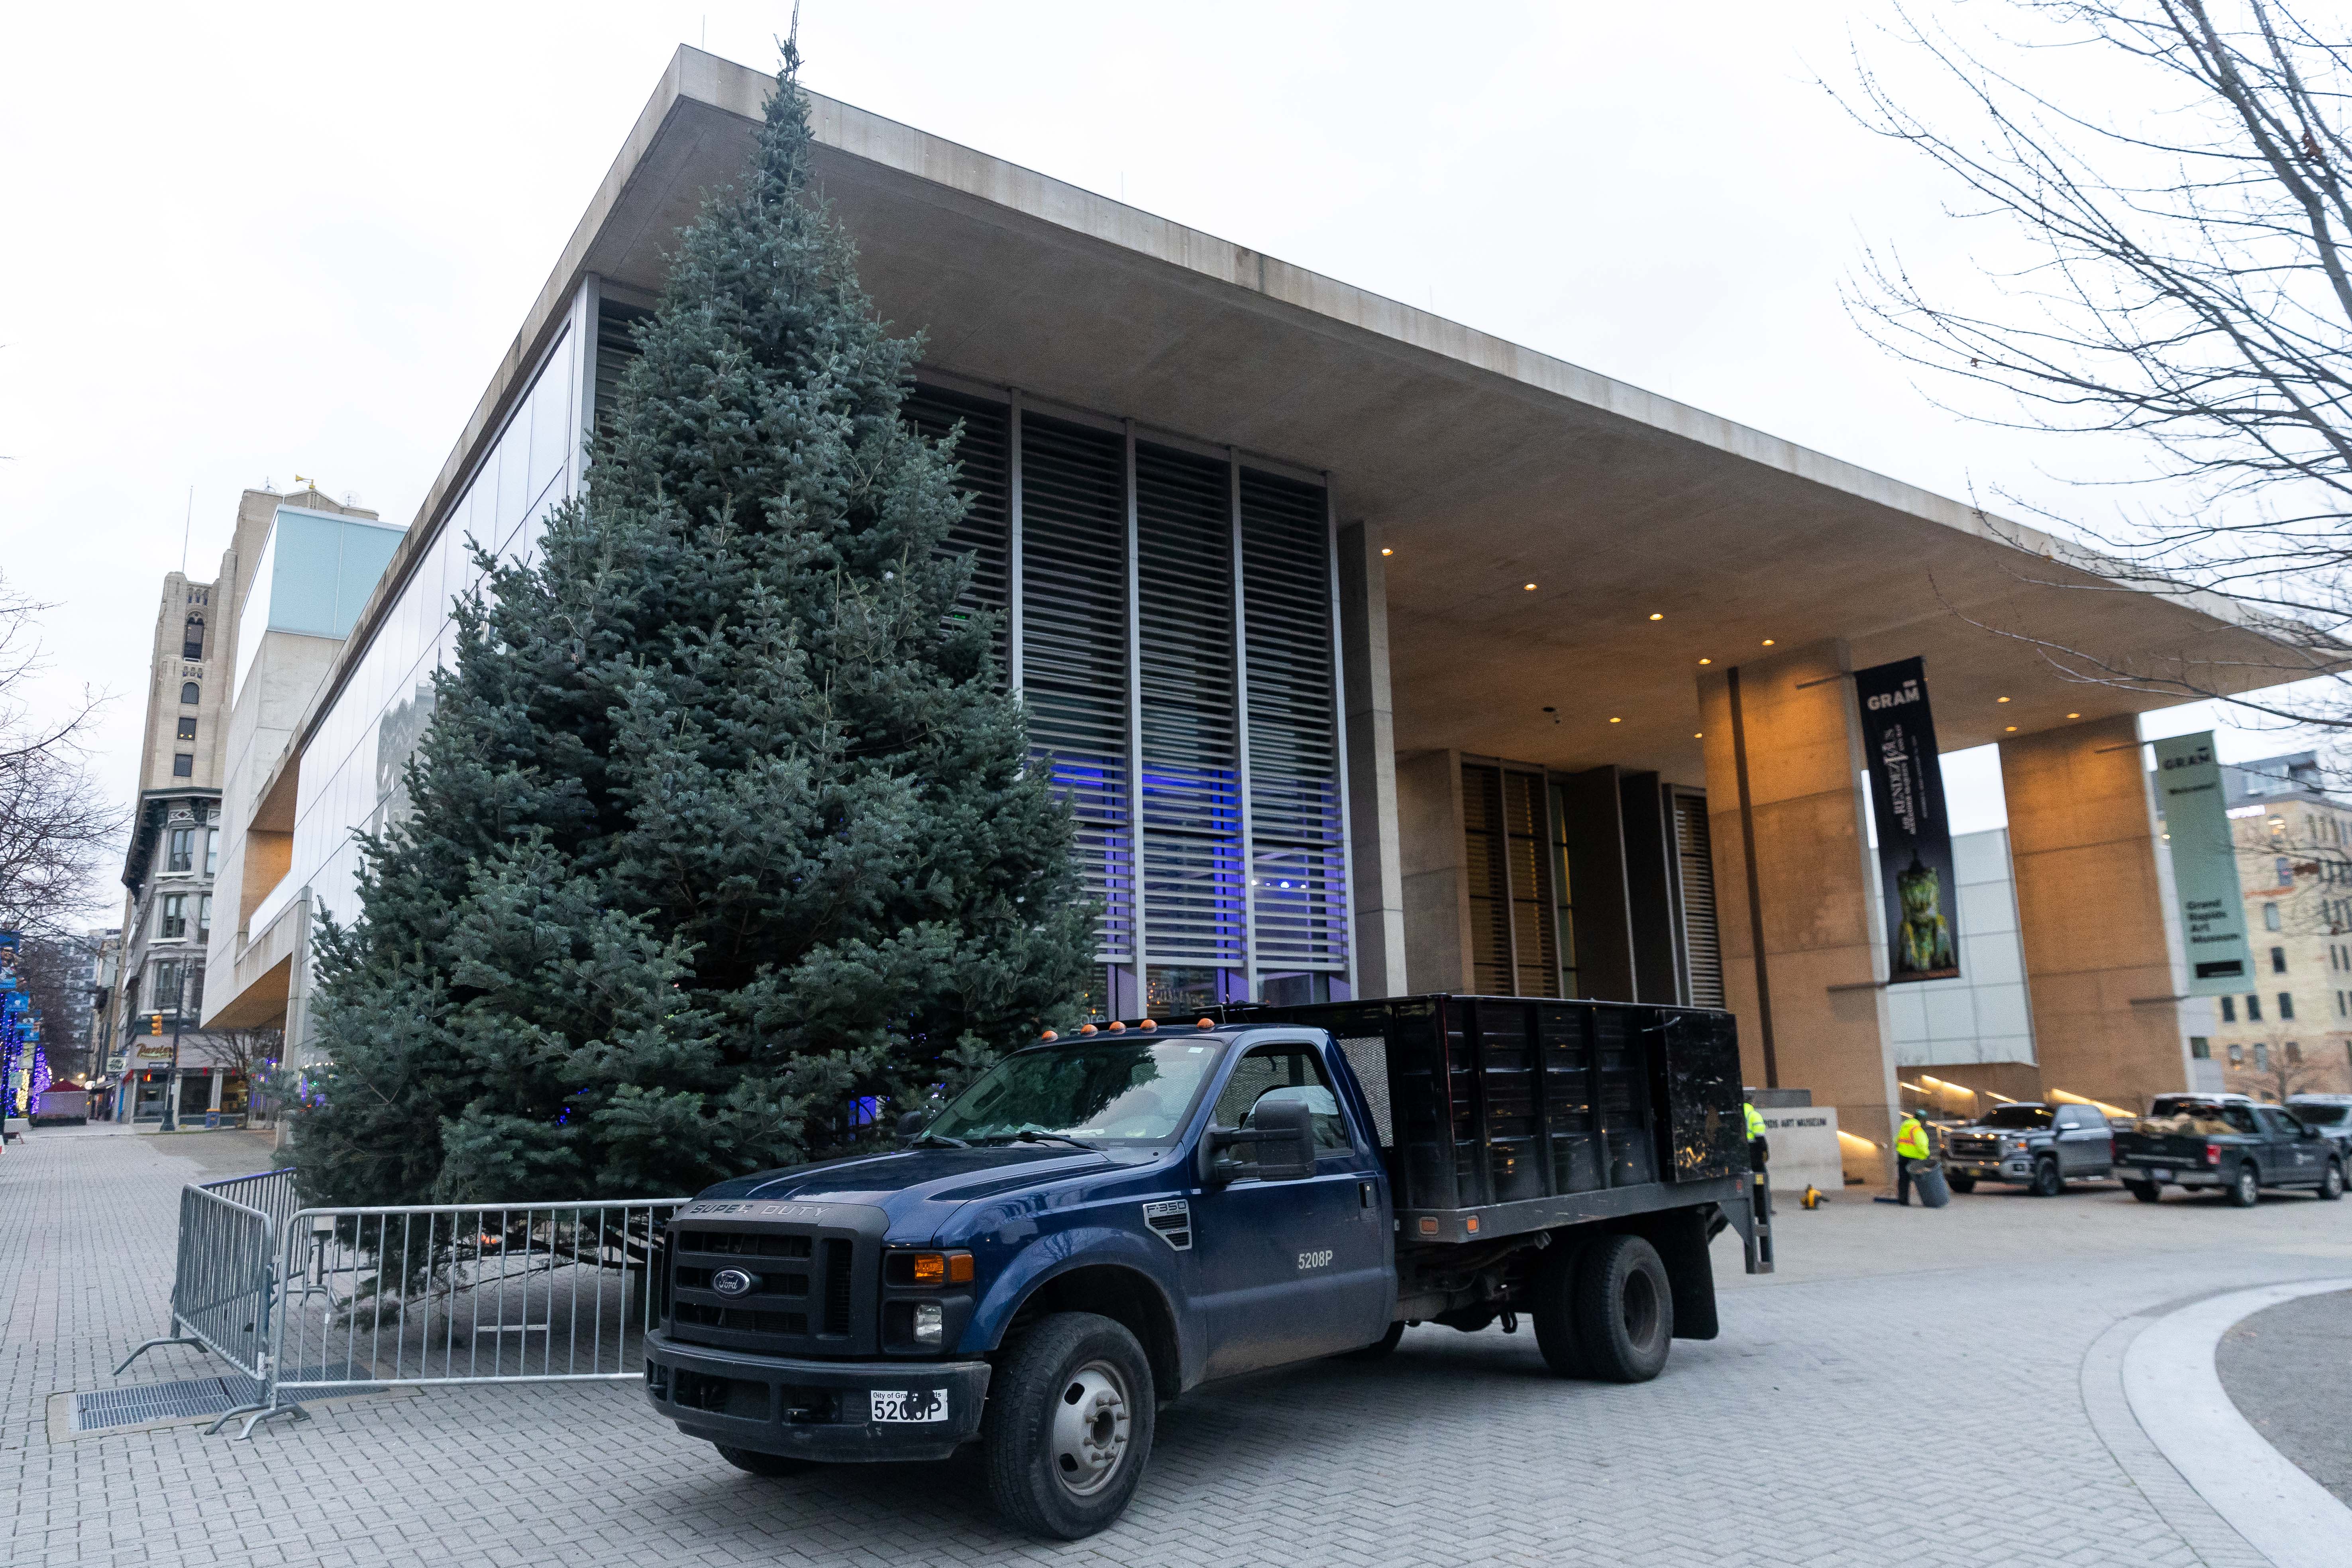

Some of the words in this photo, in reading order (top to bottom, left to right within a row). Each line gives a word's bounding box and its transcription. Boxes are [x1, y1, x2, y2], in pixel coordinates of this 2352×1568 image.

[1867, 680, 1920, 710] GRAM
[690, 1203, 754, 1214] SUPER
[760, 1205, 833, 1217] DUTY
[1298, 1250, 1333, 1269] 5208P
[719, 1274, 738, 1289] Ford
